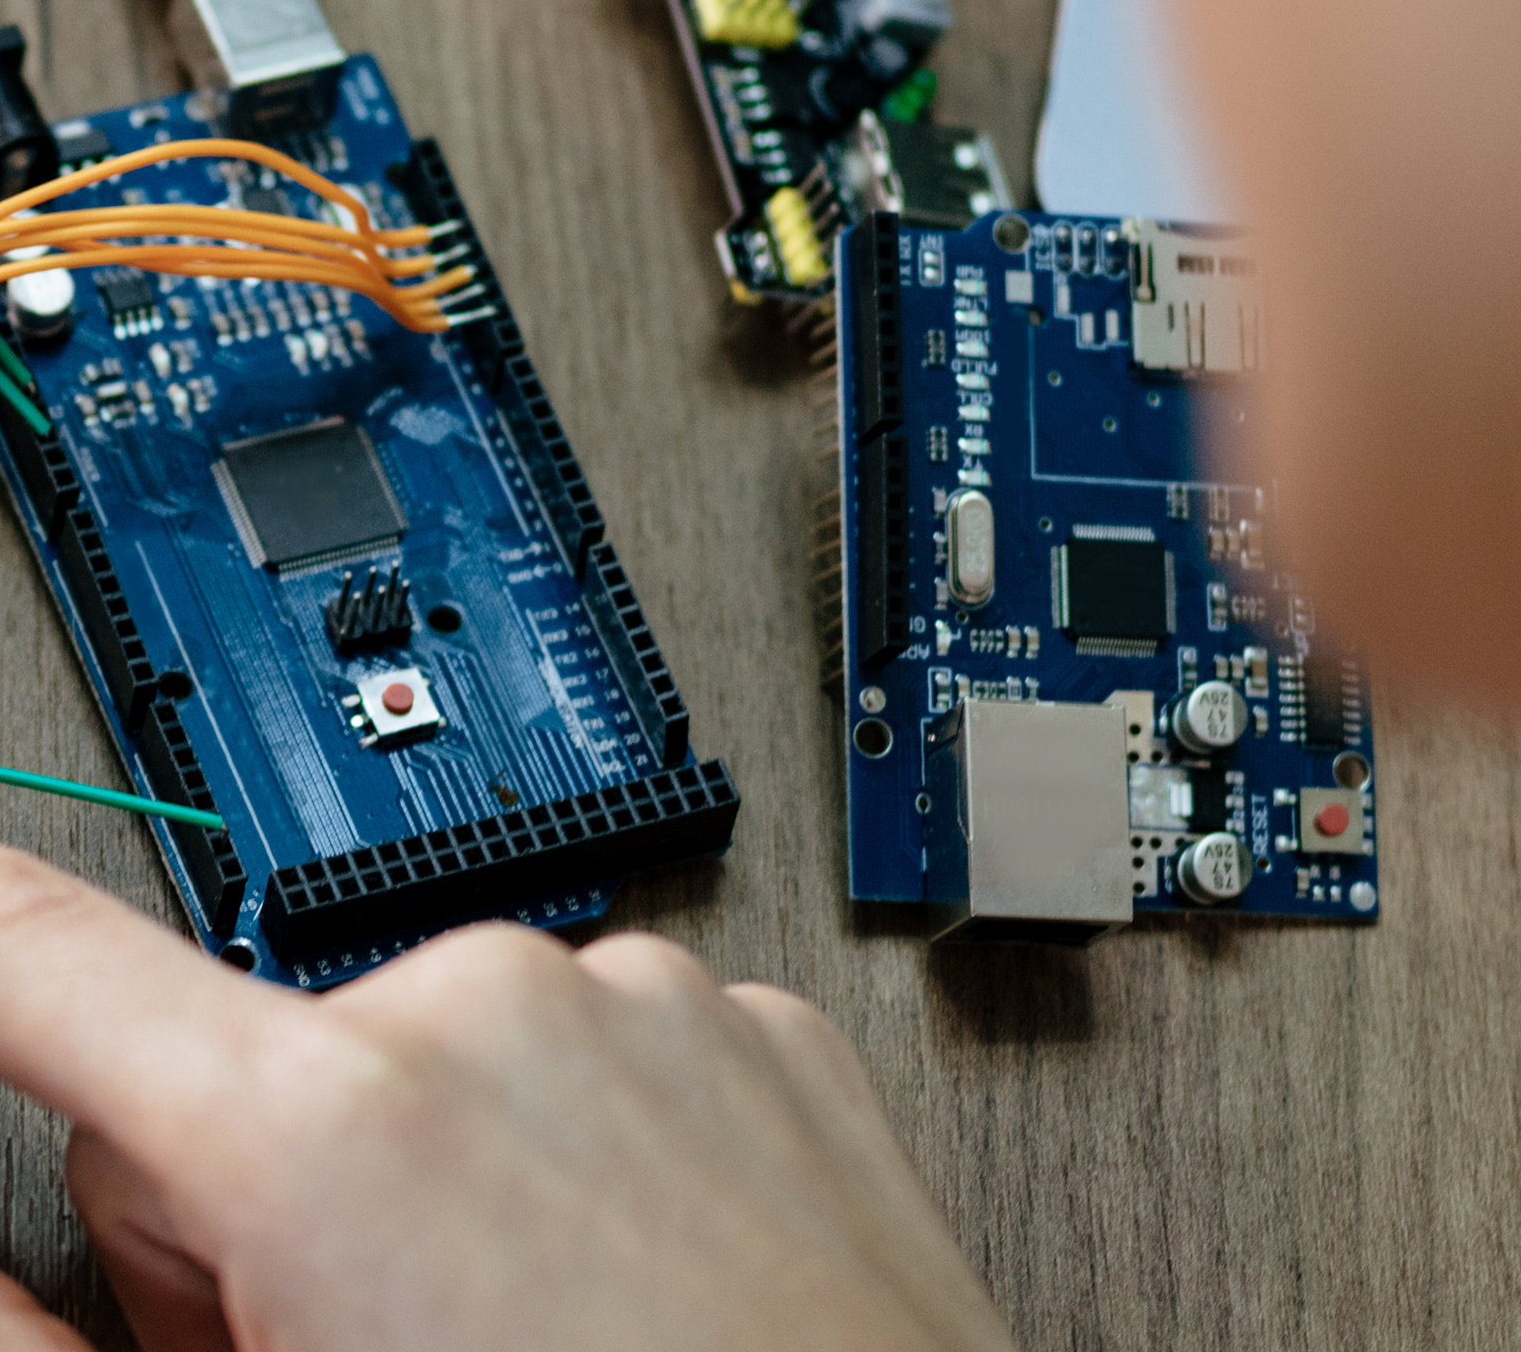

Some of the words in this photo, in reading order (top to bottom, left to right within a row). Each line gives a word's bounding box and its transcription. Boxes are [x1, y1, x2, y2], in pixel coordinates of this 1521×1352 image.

[965, 423, 984, 437] RX
[963, 455, 983, 471] TX
[1199, 691, 1229, 705] 25V
[1251, 793, 1269, 856] RESET
[1204, 843, 1233, 859] 25V
[1212, 861, 1233, 875] 47
